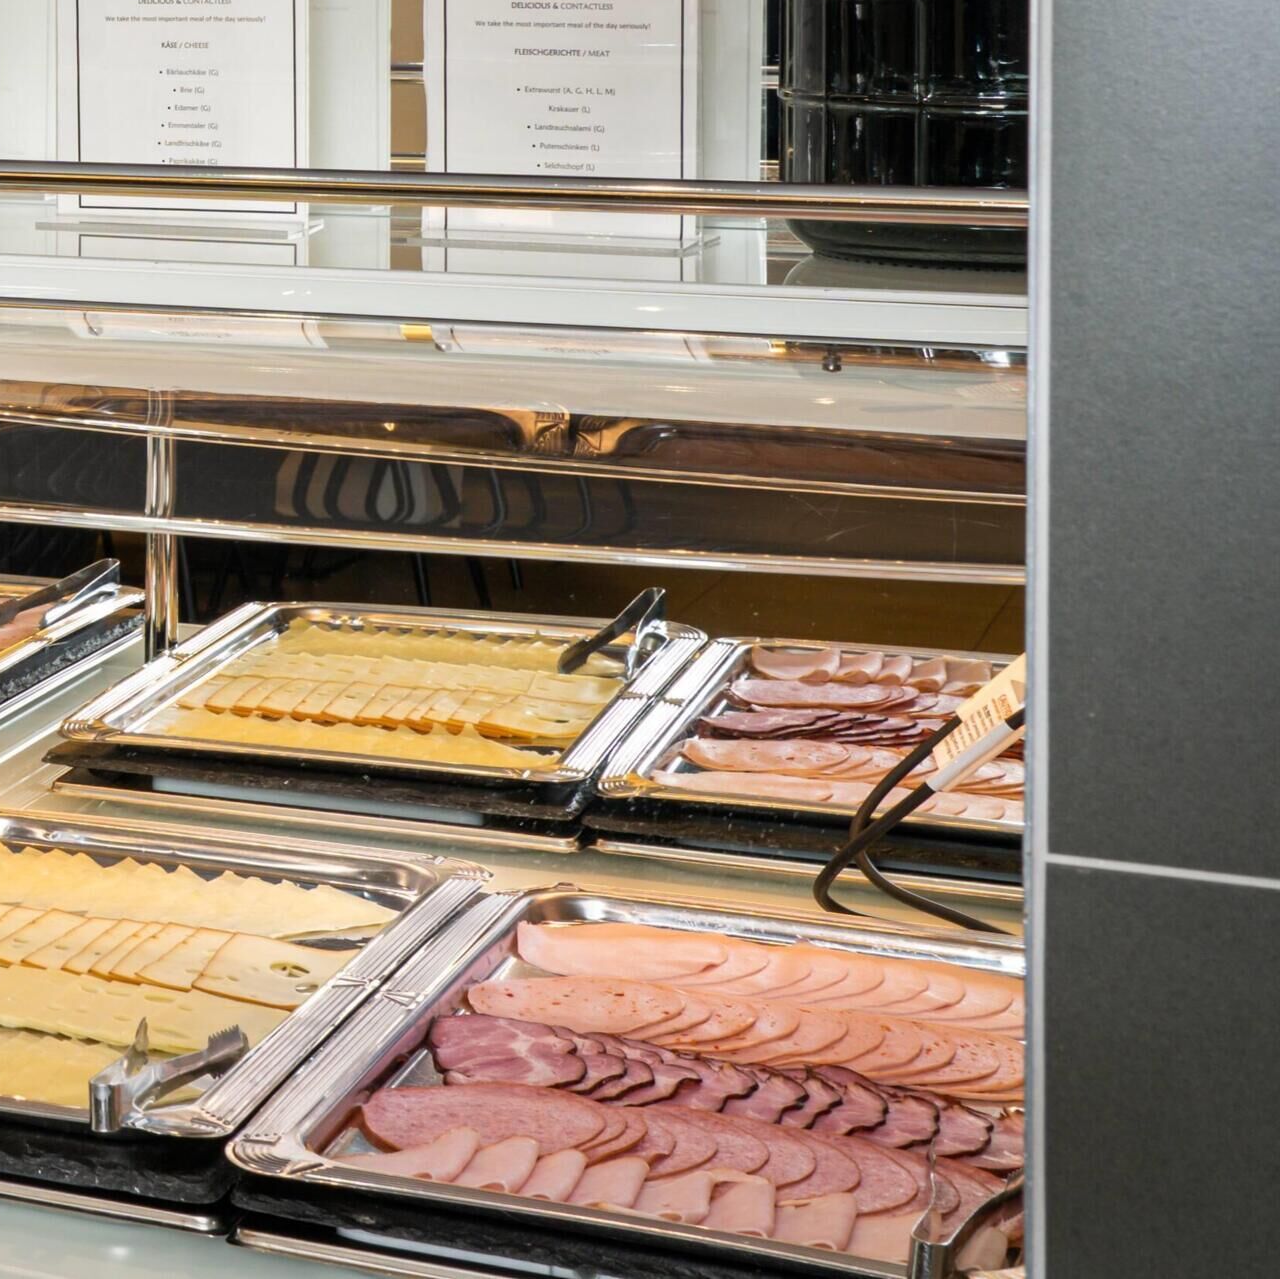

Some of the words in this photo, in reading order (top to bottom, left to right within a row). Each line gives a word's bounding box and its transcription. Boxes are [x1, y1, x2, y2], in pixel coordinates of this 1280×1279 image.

[552, 2, 558, 10] &
[560, 2, 614, 10] CONTACTLESS
[619, 23, 651, 31] seriously!
[161, 40, 177, 48] KÄSE
[514, 48, 581, 56] FLEISCHGERICHTE
[582, 49, 586, 57] /
